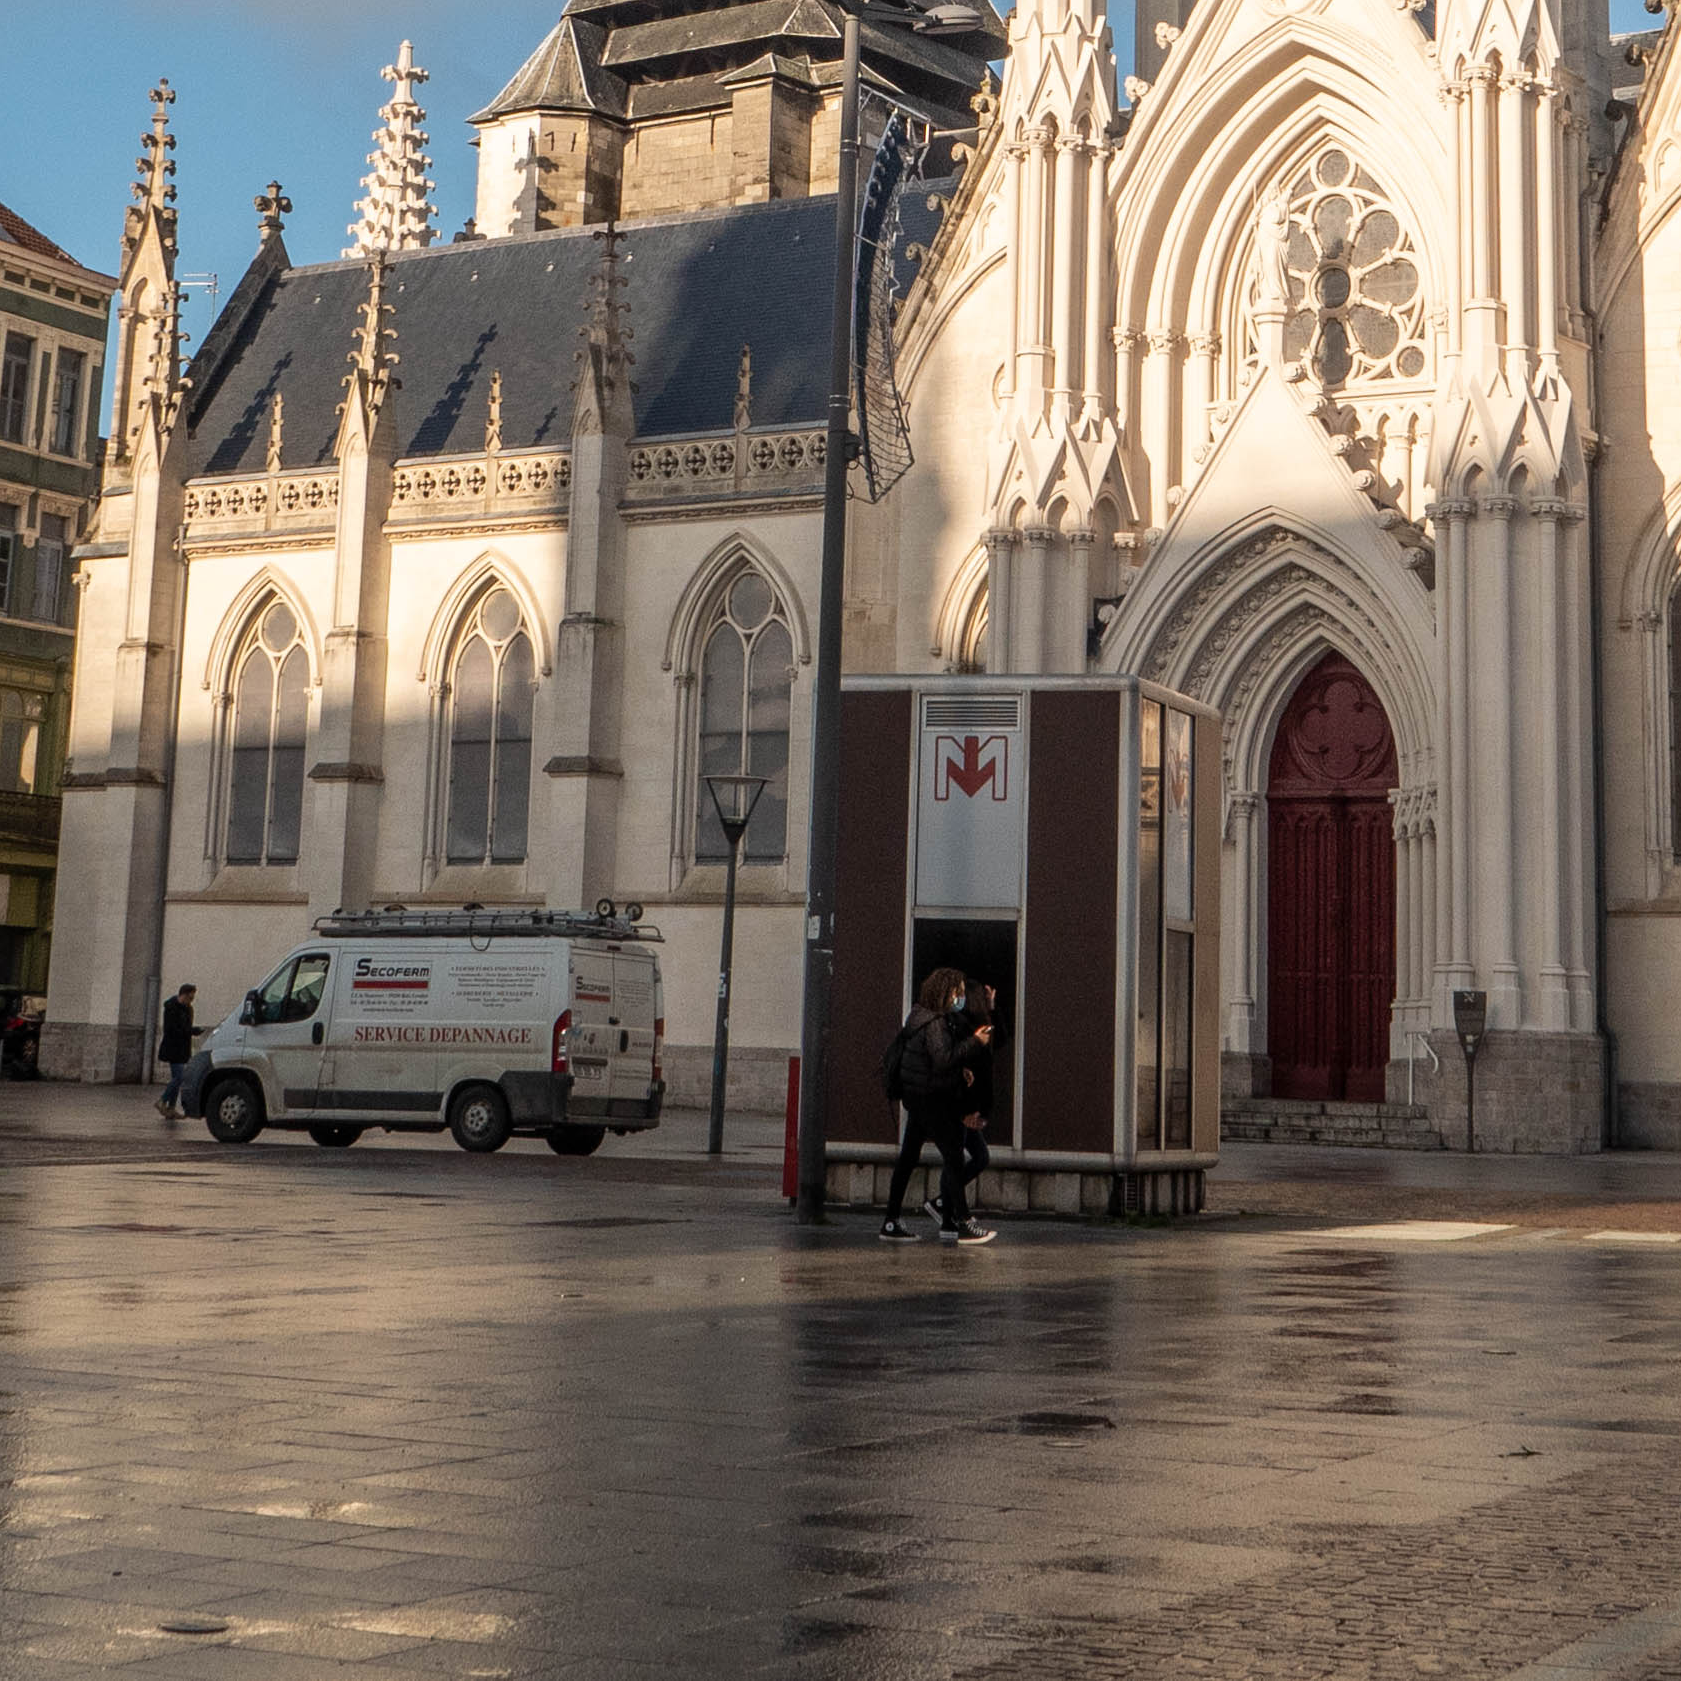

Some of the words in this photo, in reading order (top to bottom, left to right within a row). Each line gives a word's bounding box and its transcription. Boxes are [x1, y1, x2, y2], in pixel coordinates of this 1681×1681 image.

[355, 958, 430, 978] SECOFERM
[354, 1026, 426, 1044] SERVICE
[429, 1027, 532, 1044] DEPANNAGE
